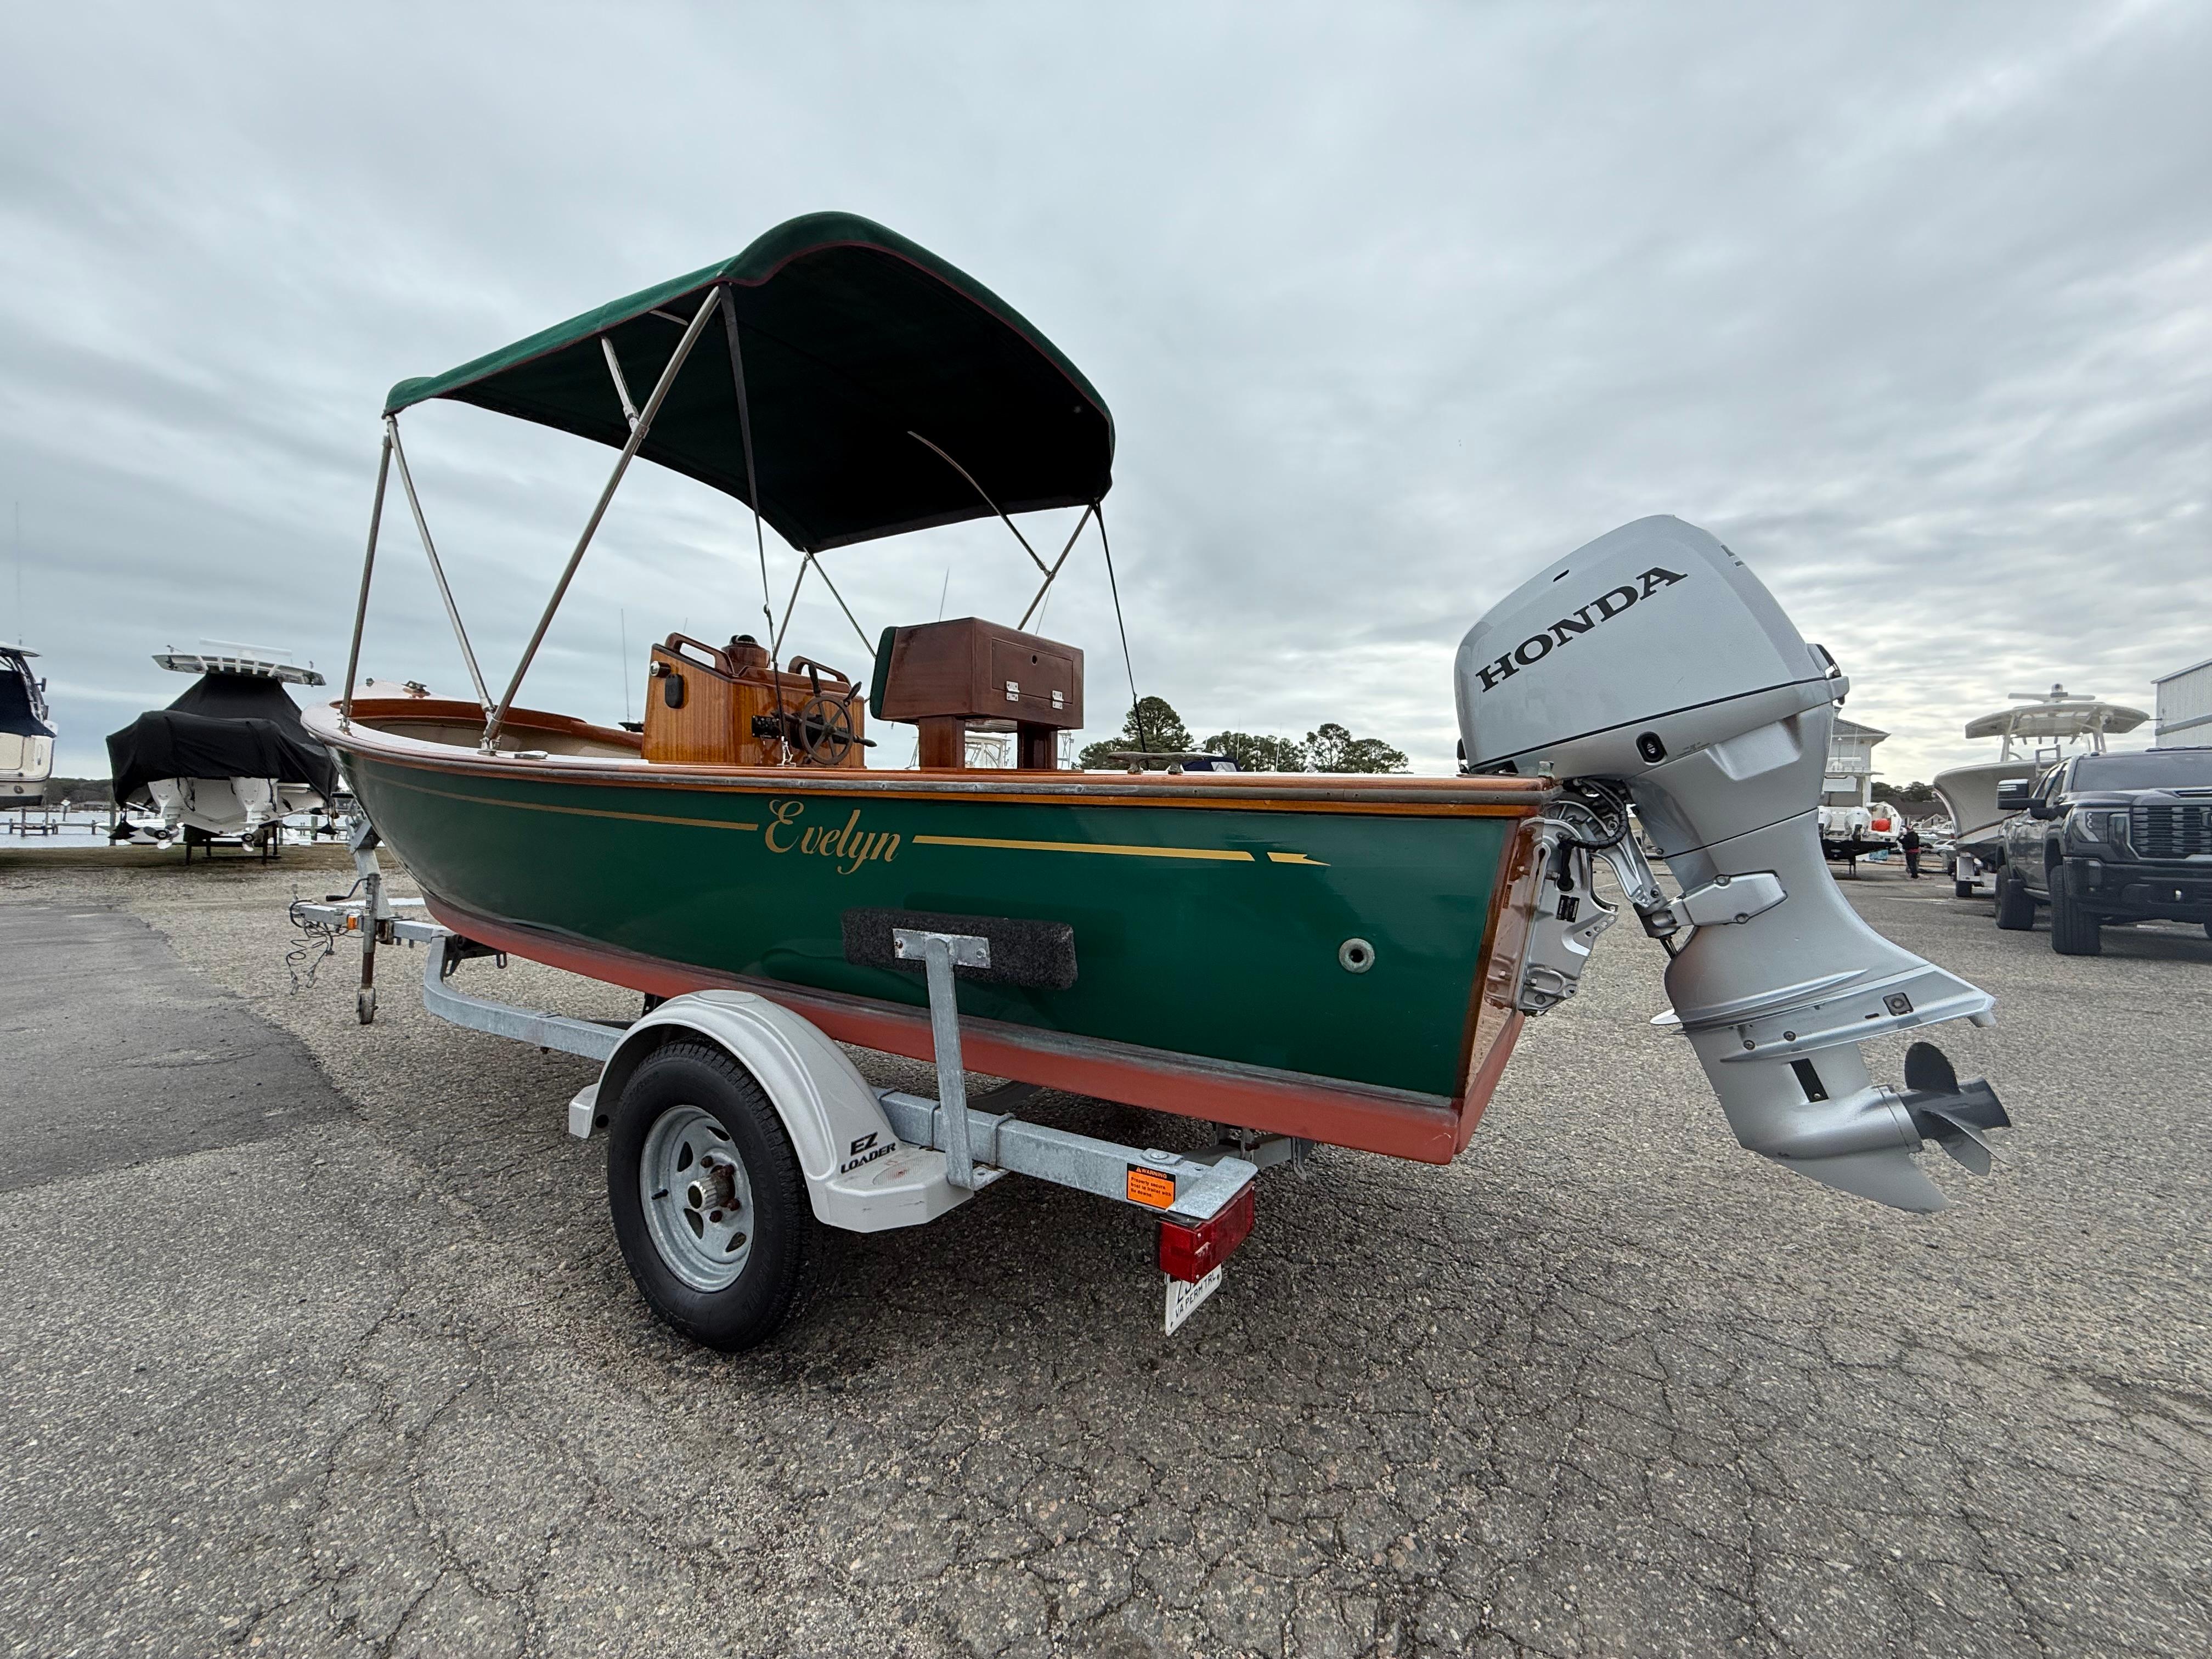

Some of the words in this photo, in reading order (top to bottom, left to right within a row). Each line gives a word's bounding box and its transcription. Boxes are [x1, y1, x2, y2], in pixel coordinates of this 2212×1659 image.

[1475, 567, 1688, 693] HONDA
[765, 799, 901, 874] Evelyn
[841, 1143, 895, 1173] LOADER
[850, 1131, 878, 1156] EZ
[1131, 1177, 1149, 1186] Properly
[1142, 1167, 1167, 1178] WARNING
[1175, 1302, 1184, 1318] VA
[1185, 1282, 1203, 1308] PERM
[1204, 1271, 1216, 1289] TRL
